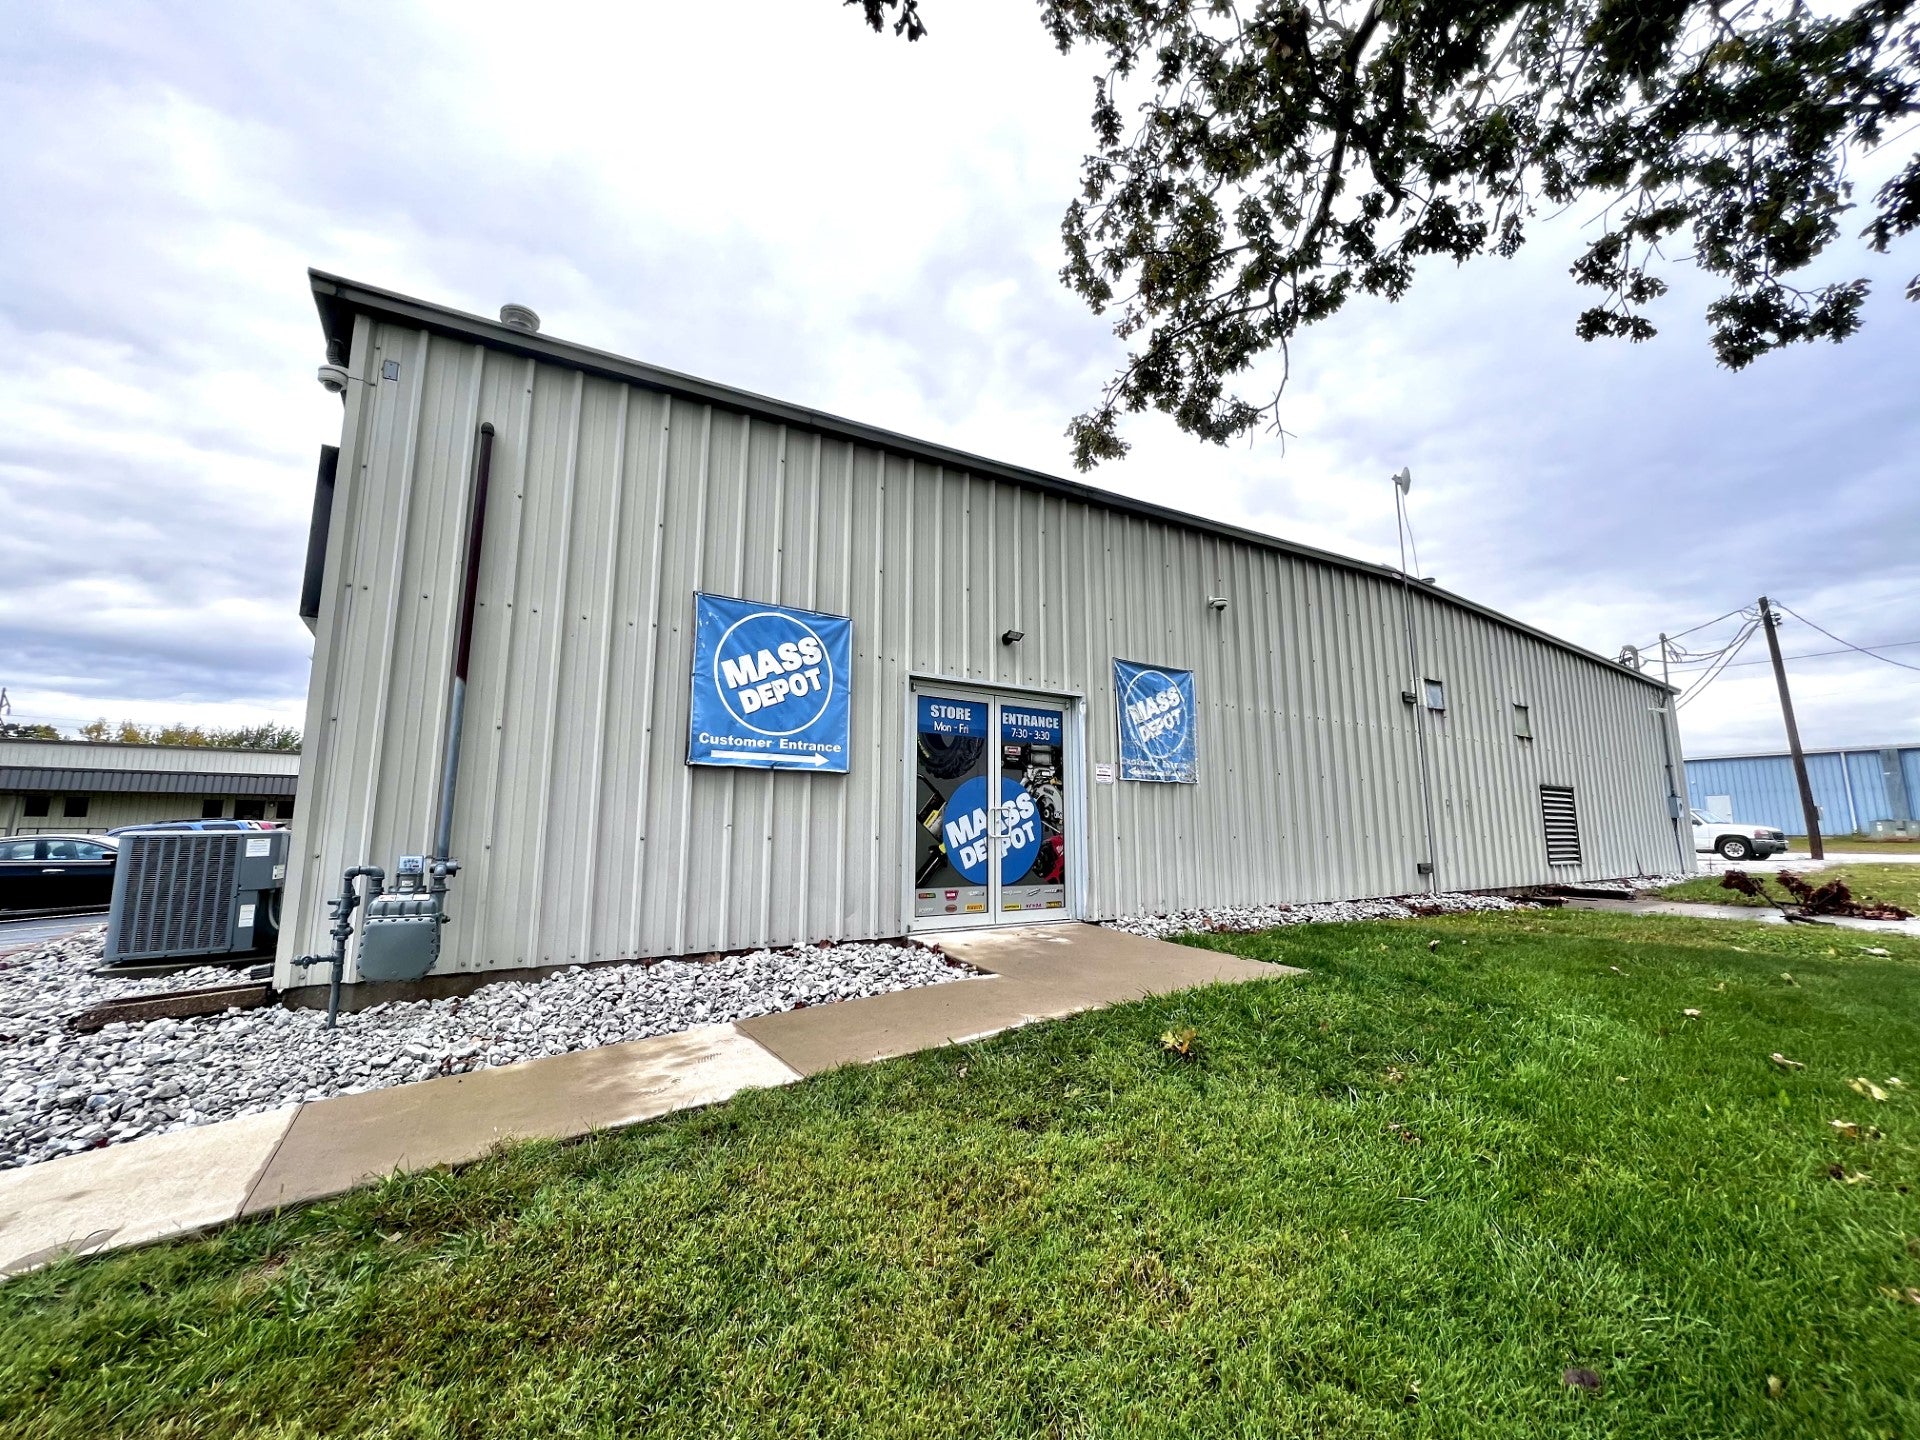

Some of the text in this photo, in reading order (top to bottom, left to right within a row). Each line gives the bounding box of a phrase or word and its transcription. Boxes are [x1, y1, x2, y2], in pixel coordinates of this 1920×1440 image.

[721, 636, 823, 690] MASS
[738, 667, 822, 714] DEPOT
[930, 704, 971, 721] STORE
[1127, 686, 1181, 726] MASS
[934, 721, 952, 732] Mon
[959, 723, 969, 734] Fri
[1002, 712, 1059, 729] ENTRANCE
[1011, 727, 1028, 739] 7:30
[1034, 730, 1050, 741] 3:30
[1139, 708, 1182, 743] DEPOT
[699, 732, 842, 753] Customer Entrance
[945, 792, 1035, 849] MASS
